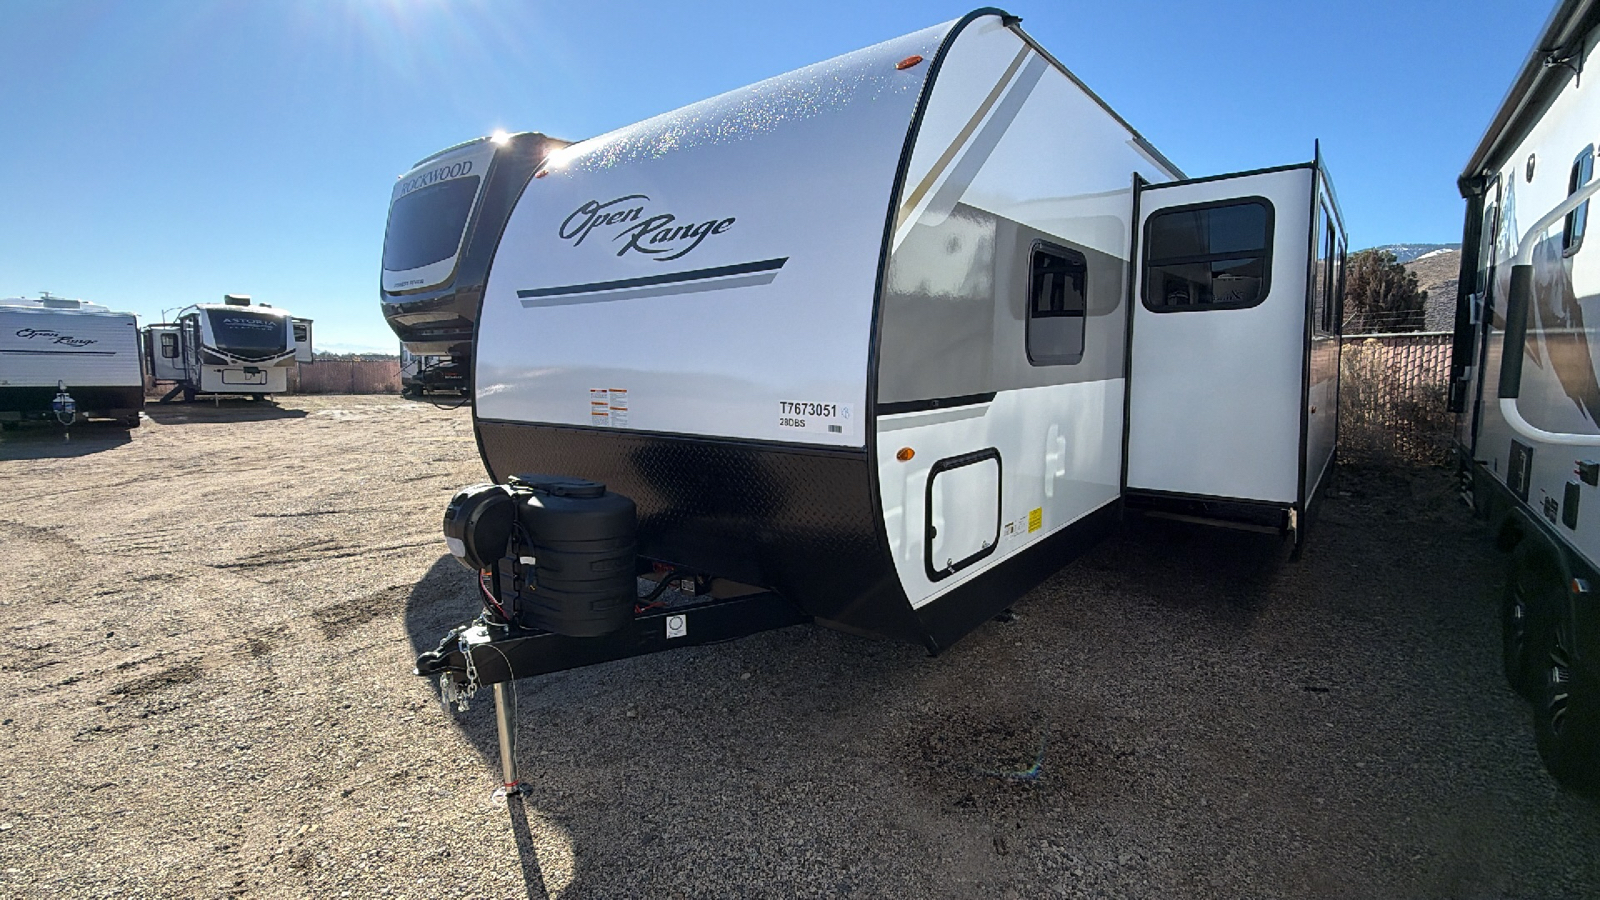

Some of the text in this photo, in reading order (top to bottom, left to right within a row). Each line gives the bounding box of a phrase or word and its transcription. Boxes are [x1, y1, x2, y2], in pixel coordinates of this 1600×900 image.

[401, 161, 472, 196] ROCKWOOD
[559, 194, 736, 262] Open Range
[223, 318, 277, 327] ASTORIA
[16, 328, 60, 339] Open
[780, 401, 837, 417] T7673051
[780, 418, 806, 428] 28DBS
